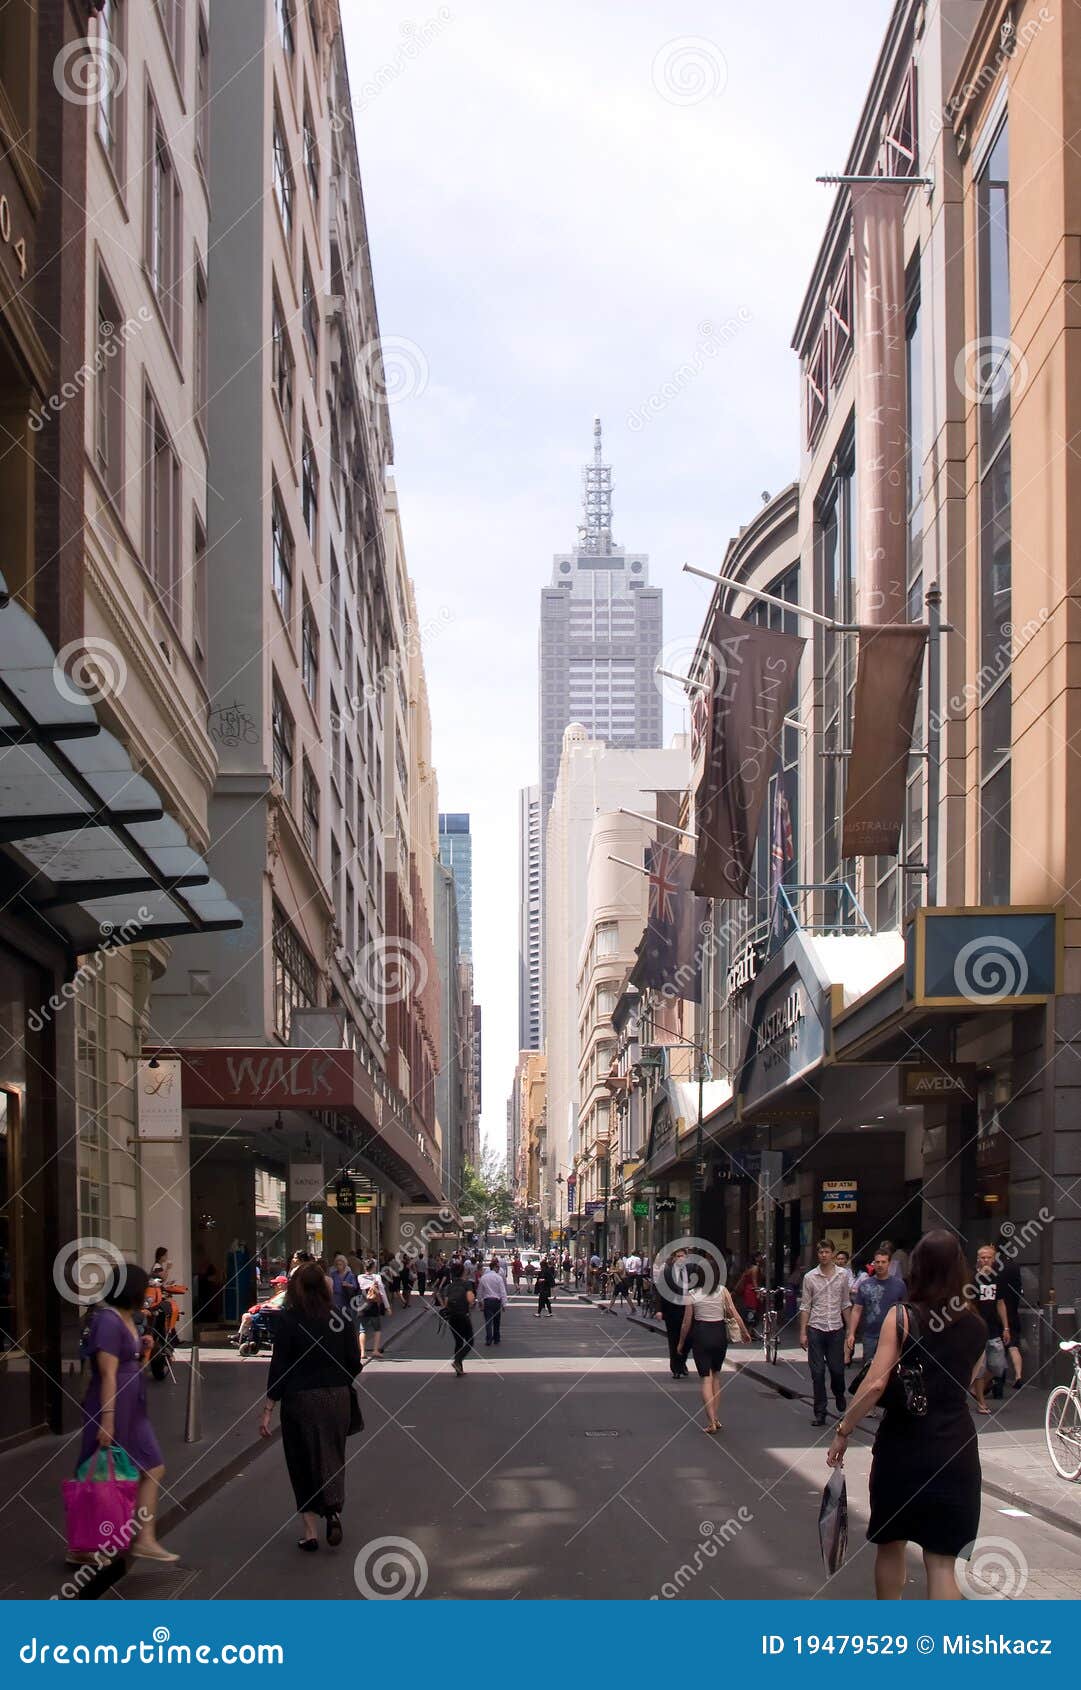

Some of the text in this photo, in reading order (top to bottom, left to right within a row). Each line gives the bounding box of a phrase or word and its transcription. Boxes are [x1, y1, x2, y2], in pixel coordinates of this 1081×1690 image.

[864, 283, 887, 612] USTRALIA
[888, 302, 902, 526] COLLINS
[739, 655, 788, 810] COLLINS
[226, 1057, 334, 1096] WALK
[915, 1076, 966, 1091] AVEDA
